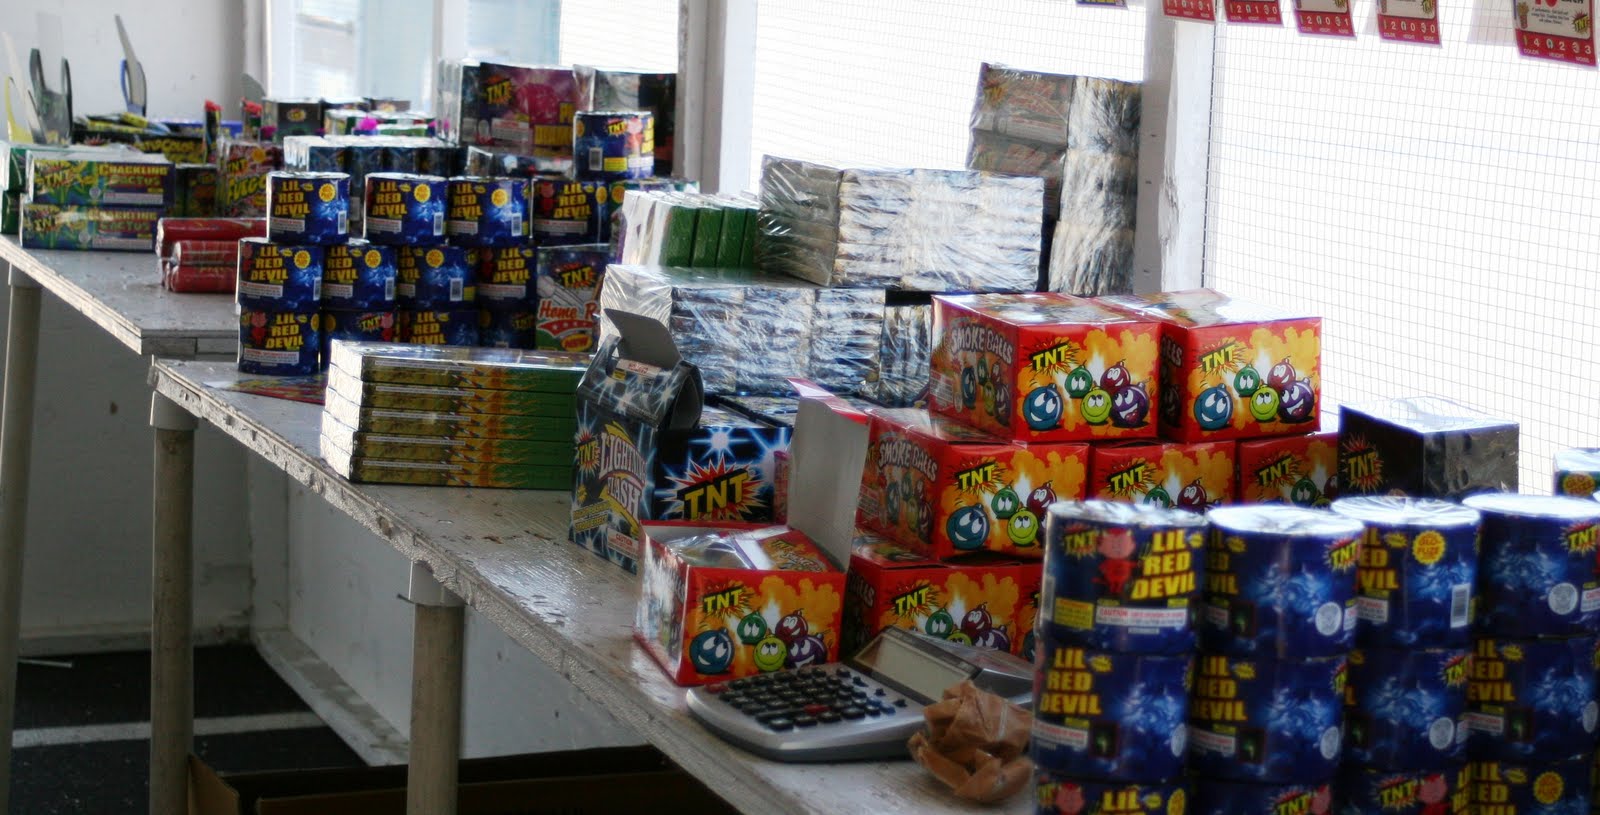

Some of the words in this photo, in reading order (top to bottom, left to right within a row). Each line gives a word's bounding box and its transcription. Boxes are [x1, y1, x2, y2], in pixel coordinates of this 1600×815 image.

[486, 79, 512, 104] TNT
[608, 120, 627, 135] TNT
[99, 163, 168, 176] CRACKLING
[282, 180, 300, 191] LIL
[379, 181, 397, 192] LIL
[456, 183, 474, 194] LIL
[564, 182, 583, 195] LIL
[278, 191, 304, 203] RED
[376, 192, 402, 203] RED
[453, 194, 477, 206] RED
[559, 193, 587, 205] RED
[275, 203, 310, 216] DEVIL
[372, 203, 407, 216] DEVIL
[554, 204, 591, 219] DEVIL
[260, 246, 279, 257] LIL
[329, 246, 350, 257] LIL
[501, 247, 521, 258] LIL
[255, 257, 283, 268] RED
[327, 257, 353, 268] RED
[497, 258, 525, 270] RED
[251, 269, 288, 281] DEVIL
[493, 269, 530, 283] DEVIL
[561, 266, 593, 288] TNT
[417, 312, 436, 323] LIL
[539, 299, 579, 319] Home
[275, 313, 296, 325] LIL
[360, 314, 382, 330] TNT
[414, 323, 440, 334] RED
[271, 325, 299, 336] RED
[265, 336, 303, 349] DEVIL
[951, 326, 985, 352] SMOKE
[986, 328, 1013, 365] BALLS
[1032, 344, 1069, 371] TNT
[1202, 344, 1235, 372] TNT
[578, 440, 597, 464] TNT
[600, 431, 647, 484] LIGHTNING
[879, 440, 911, 468] SMOKE
[911, 449, 937, 482] BALLS
[1259, 457, 1292, 486] TNT
[1349, 452, 1377, 481] TNT
[959, 464, 996, 491] TNT
[1110, 465, 1145, 493] TNT
[607, 477, 642, 516] FLASH
[684, 471, 750, 521] TNT
[1064, 529, 1098, 555] TNT
[1152, 529, 1187, 552] LIL
[1362, 527, 1381, 545] IL
[1568, 524, 1598, 551] TNT
[1143, 551, 1192, 576] RED
[1331, 539, 1358, 569] TNT
[1359, 547, 1388, 567] ED
[1131, 571, 1196, 600] DEVIL
[1360, 569, 1399, 590] VIL
[704, 588, 743, 613] TNT
[895, 587, 929, 615] TNT
[1477, 639, 1498, 658] IL
[1054, 648, 1086, 669] LIL
[1474, 661, 1504, 679] ED
[1046, 671, 1093, 692] RED
[1103, 789, 1140, 811] LIL
[1381, 779, 1416, 806] TNT
[1278, 794, 1312, 815] TNT
